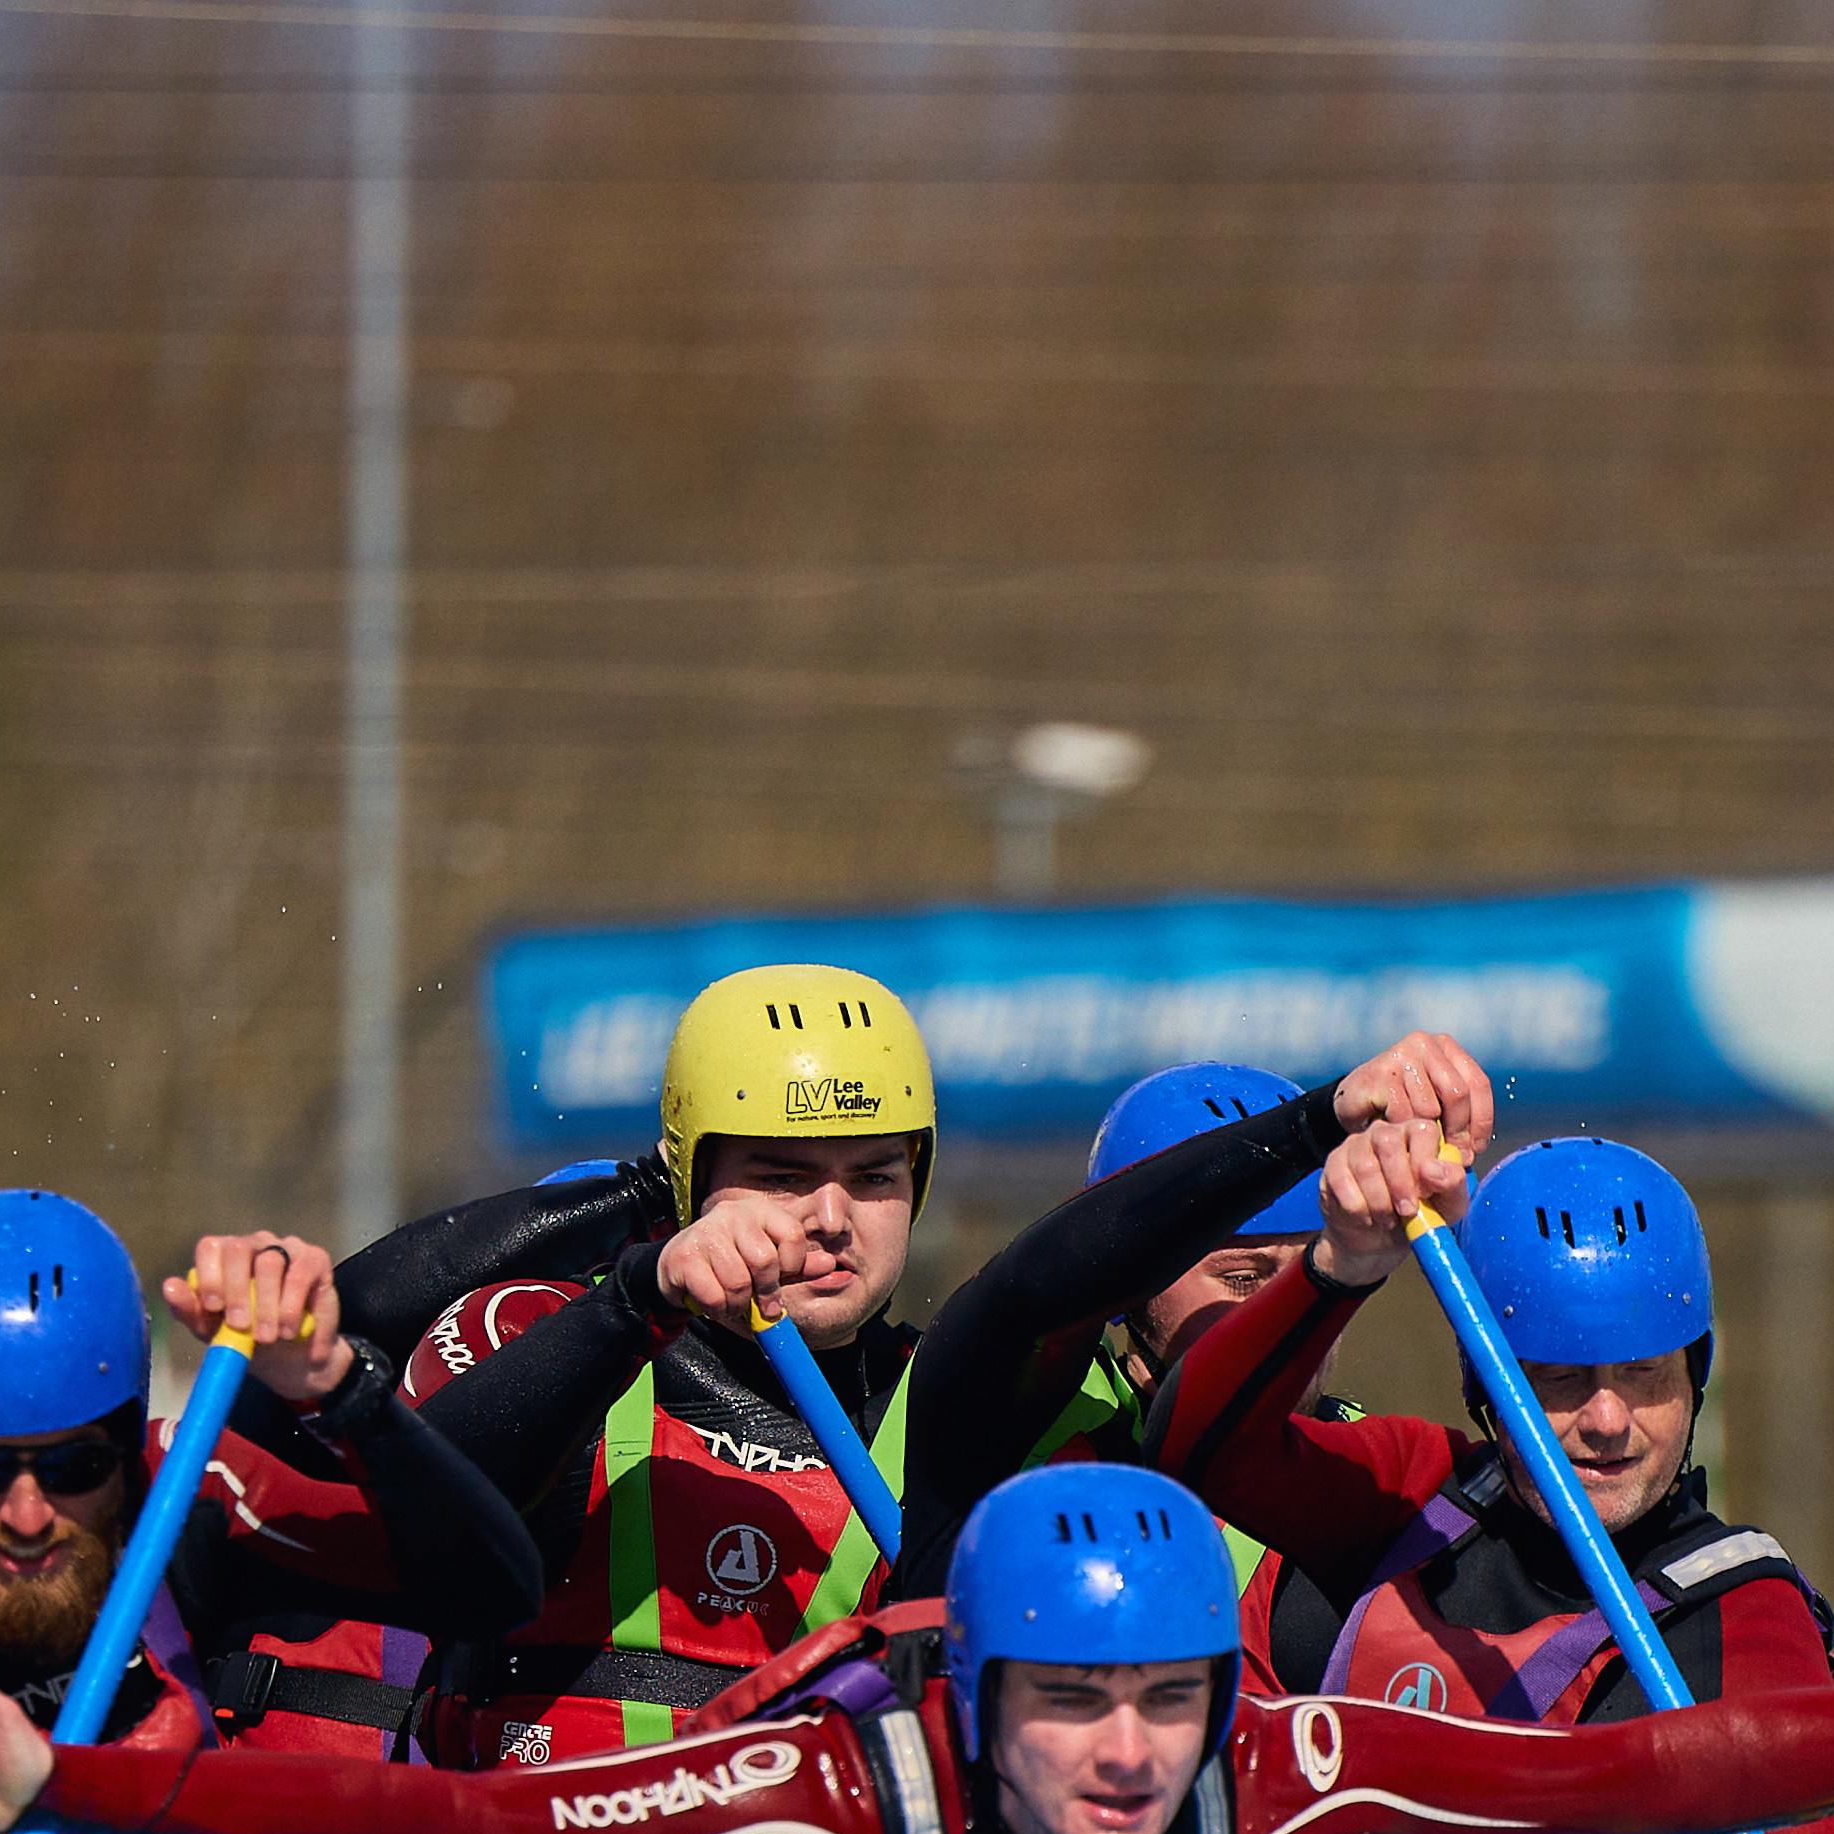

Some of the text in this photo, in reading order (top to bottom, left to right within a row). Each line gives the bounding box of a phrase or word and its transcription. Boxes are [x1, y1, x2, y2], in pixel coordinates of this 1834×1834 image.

[786, 1078, 864, 1115] LV Lee
[833, 1094, 882, 1113] Valley
[503, 1720, 553, 1741] CENTRE
[499, 1735, 551, 1766] PRO
[551, 1762, 767, 1832] TYPHOON
